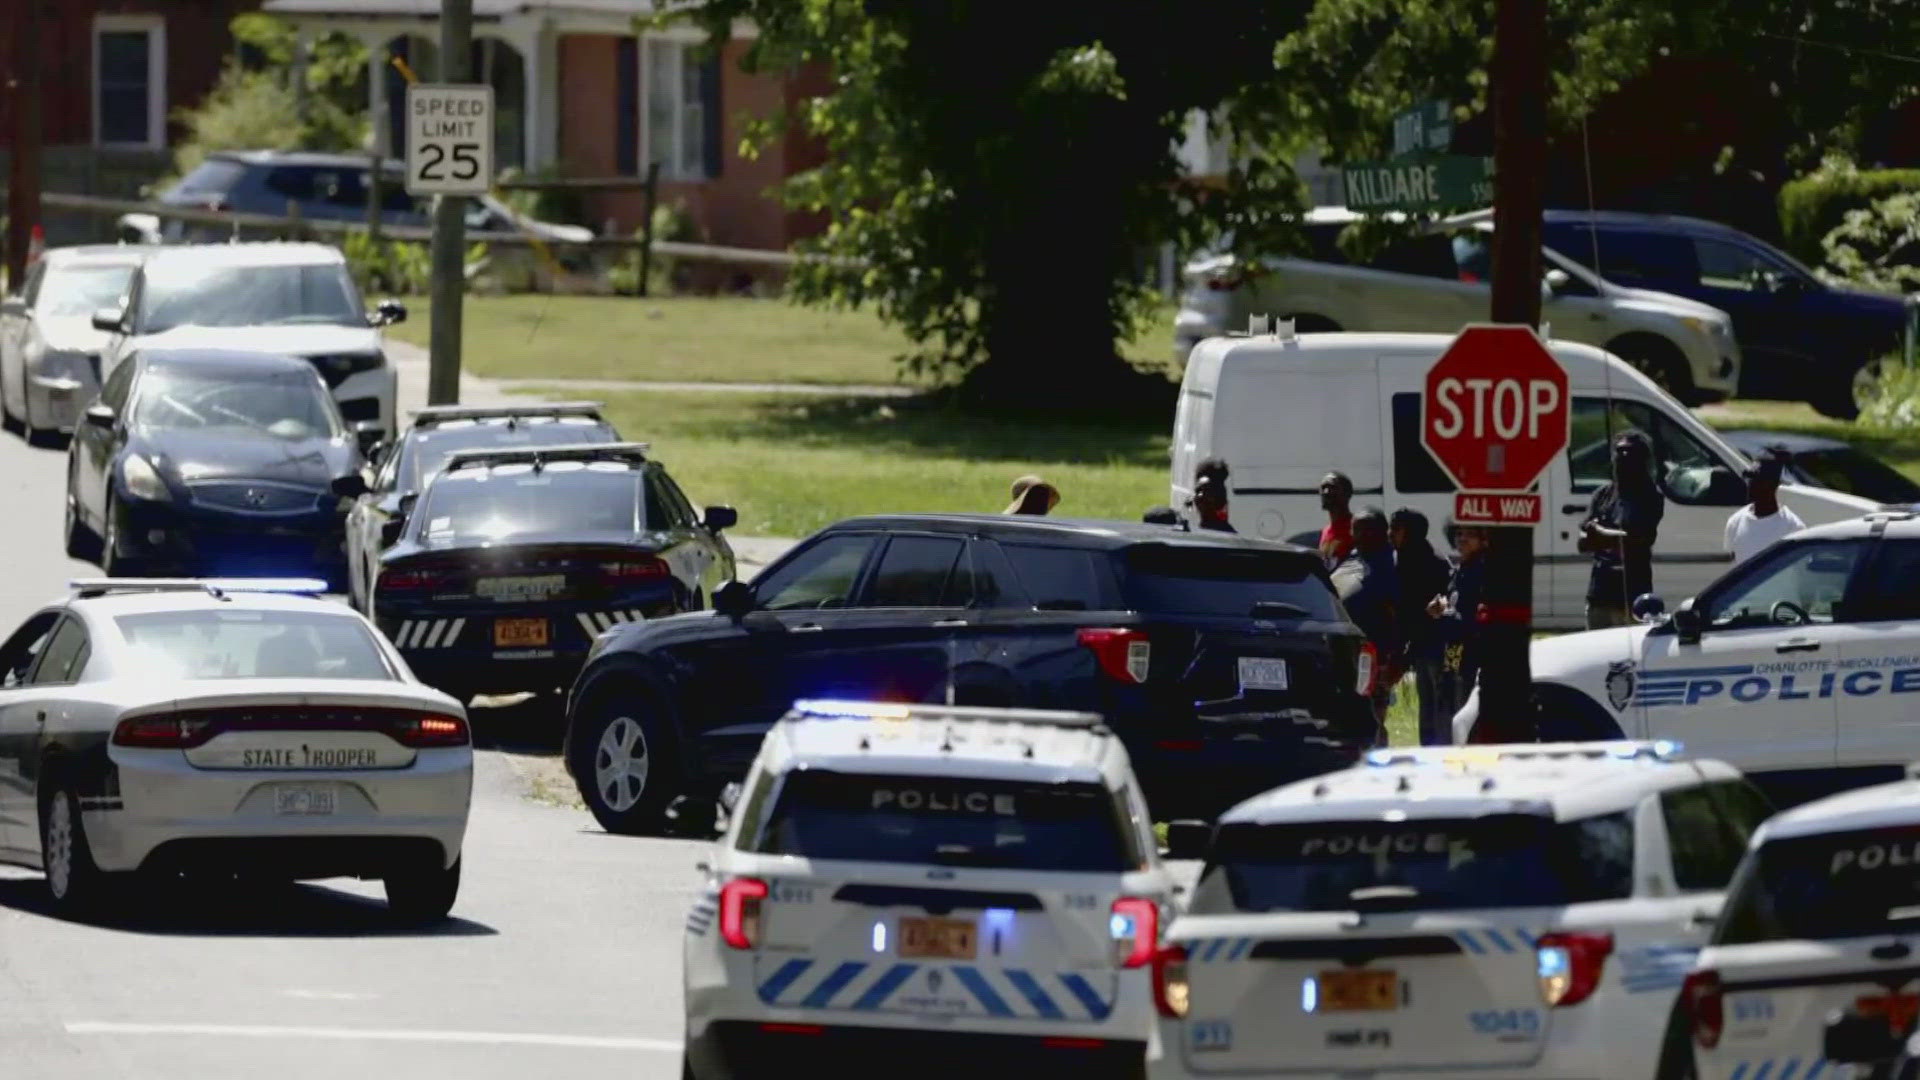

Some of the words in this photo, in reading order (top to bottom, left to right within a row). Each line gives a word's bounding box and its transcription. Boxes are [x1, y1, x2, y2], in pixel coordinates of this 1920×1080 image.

[415, 99, 484, 116] SPEED
[422, 121, 475, 137] LIMIT
[419, 144, 479, 180] 25
[1346, 165, 1440, 206] KILDARE
[1433, 377, 1559, 440] STOP
[1461, 498, 1492, 517] ALL
[1501, 499, 1535, 518] WAY
[1685, 668, 1920, 705] POLICE
[243, 750, 294, 766] STATE
[302, 749, 376, 766] TROOPER
[872, 789, 1016, 815] POLICE
